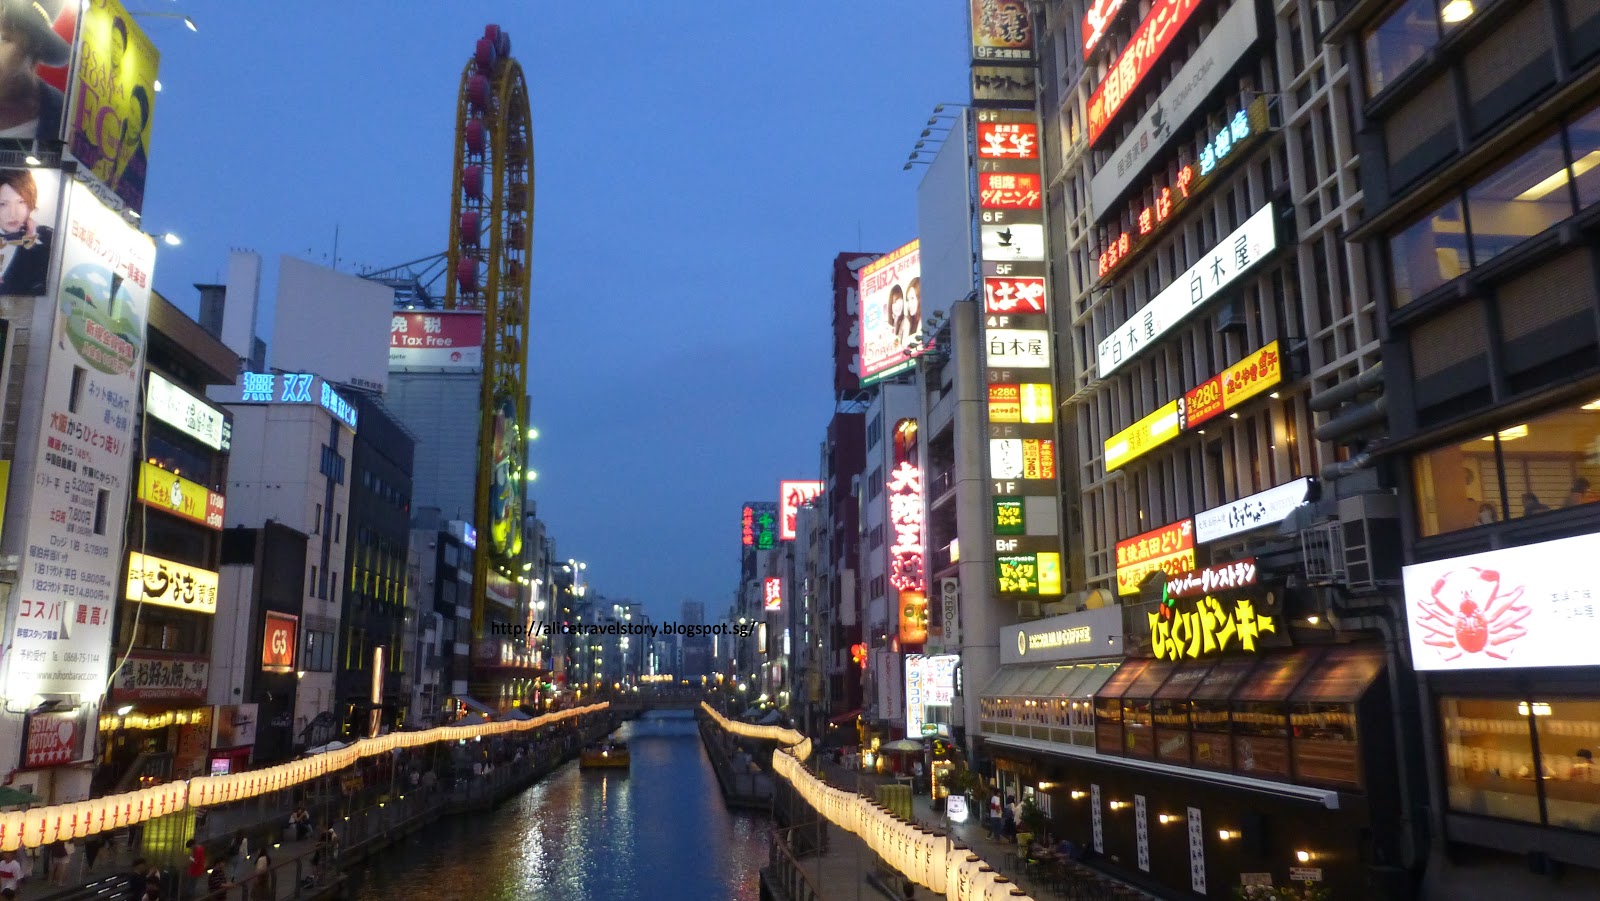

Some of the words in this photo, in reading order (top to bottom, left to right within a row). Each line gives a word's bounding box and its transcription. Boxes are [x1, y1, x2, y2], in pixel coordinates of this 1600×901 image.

[981, 190, 1040, 206] ダイニング
[982, 212, 1004, 222] 6F
[996, 264, 1013, 275] 5F
[1190, 234, 1251, 305] 白木屋
[987, 316, 1009, 328] 4F
[402, 335, 423, 345] Tax
[426, 335, 452, 346] Free
[990, 336, 1044, 356] 白木屋
[1112, 311, 1156, 365] 白木屋
[995, 482, 1015, 493] 1F
[20, 600, 61, 620] コスパ
[1148, 595, 1276, 661] びっくりドンキー
